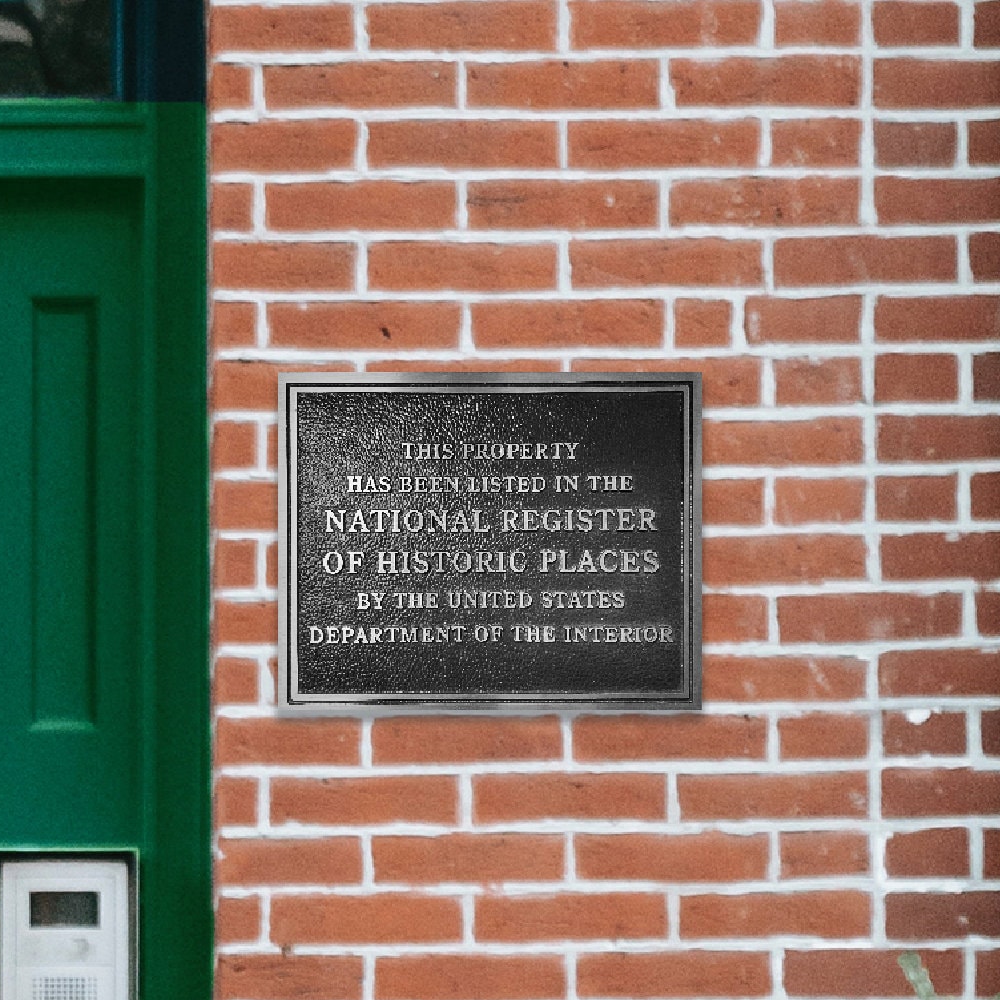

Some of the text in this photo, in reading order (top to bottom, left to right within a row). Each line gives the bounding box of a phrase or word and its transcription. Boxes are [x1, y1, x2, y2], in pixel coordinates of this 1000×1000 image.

[401, 442, 579, 460] THIS PROPERTY
[347, 475, 633, 493] HAS BEEN LISTED IN THE
[325, 508, 658, 533] NATIONAL REGISTER
[322, 549, 660, 574] OF HISTORIC PLACES
[357, 591, 625, 610] BY THE UNITED STATES
[308, 625, 674, 644] DEPARTMENT OF THE INTERIOR
